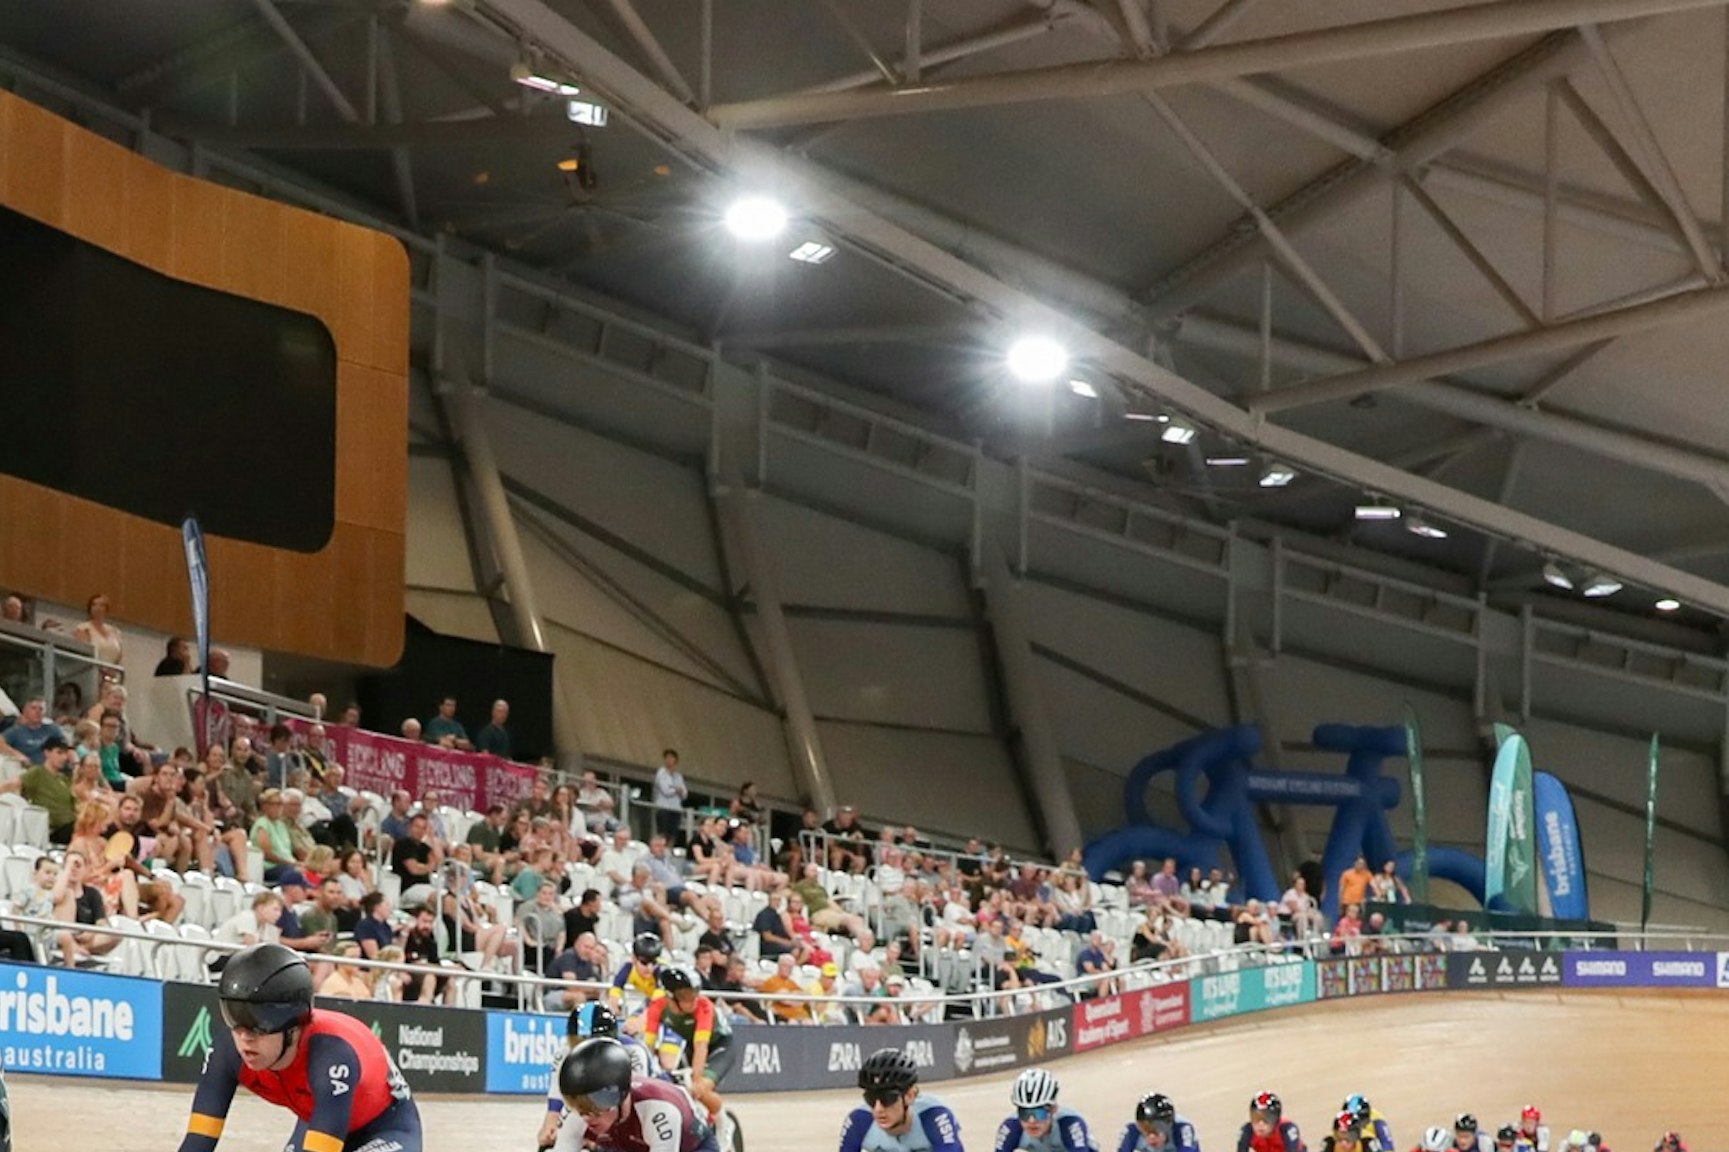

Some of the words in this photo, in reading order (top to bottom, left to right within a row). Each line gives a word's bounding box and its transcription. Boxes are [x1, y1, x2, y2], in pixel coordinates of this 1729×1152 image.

[1544, 810, 1571, 896] brisbane
[1576, 960, 1627, 977] SHIMANO
[1652, 961, 1705, 977] SHIMANO
[398, 1024, 443, 1047] National
[3, 1046, 106, 1072] australia
[398, 1052, 480, 1074] Championships
[328, 1064, 350, 1097] SA
[651, 1111, 674, 1142] QLD
[934, 1112, 956, 1145] NSW
